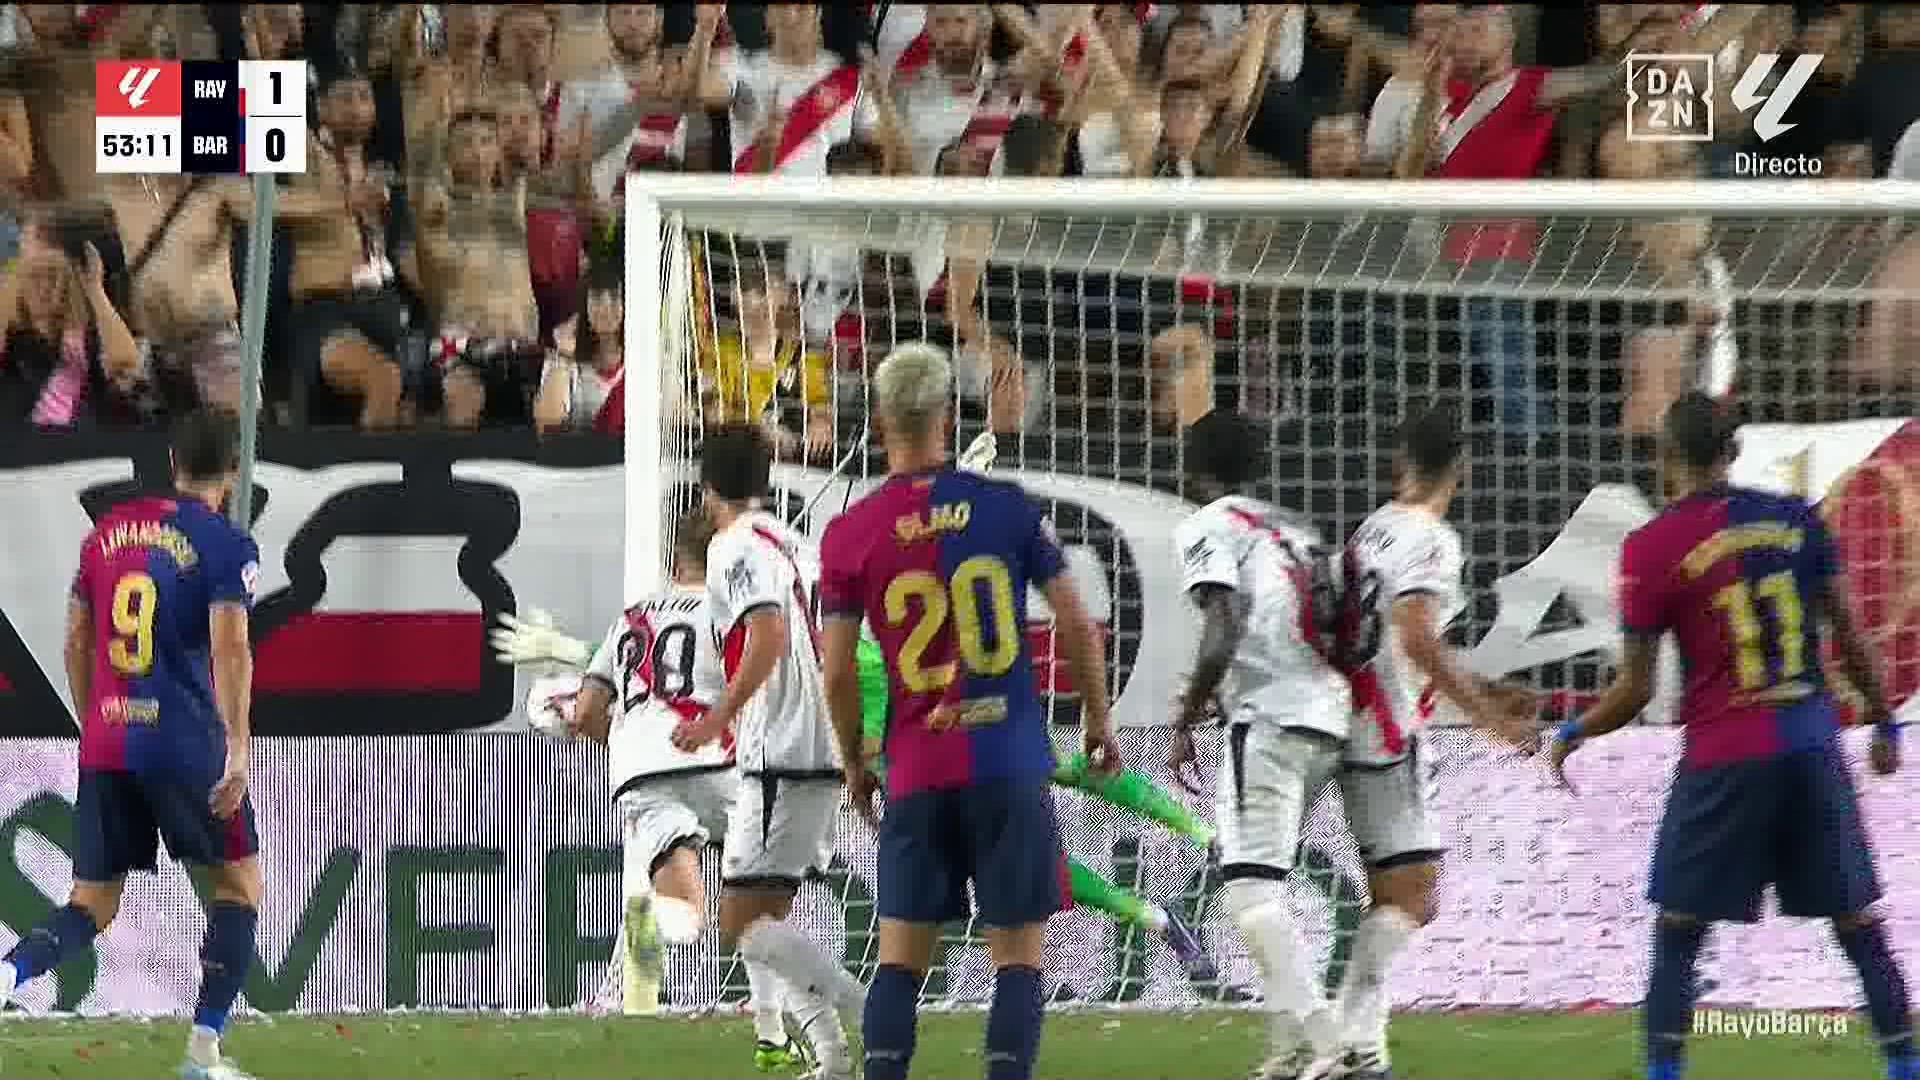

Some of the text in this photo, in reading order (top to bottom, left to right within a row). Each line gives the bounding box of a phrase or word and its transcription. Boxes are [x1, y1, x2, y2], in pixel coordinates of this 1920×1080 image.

[109, 572, 158, 677] 9
[884, 556, 1020, 692] 20
[1711, 571, 1805, 690] 11
